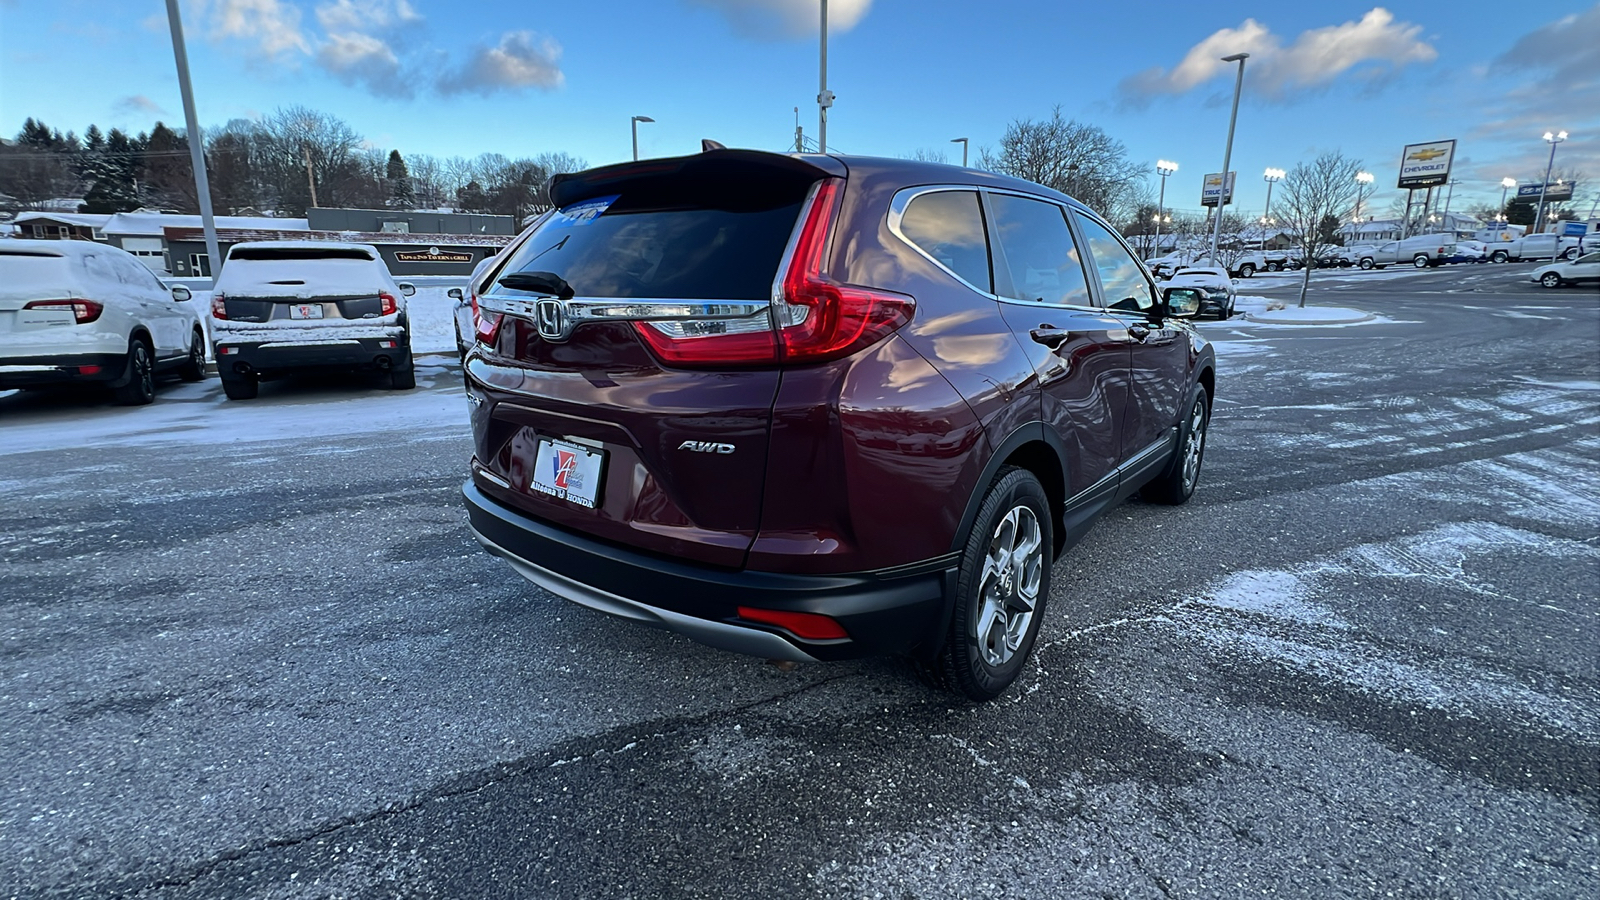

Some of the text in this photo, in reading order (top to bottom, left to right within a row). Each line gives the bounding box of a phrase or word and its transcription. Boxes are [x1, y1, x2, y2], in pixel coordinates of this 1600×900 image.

[1404, 163, 1446, 173] CHEVROLET
[1205, 188, 1230, 196] TRUCS
[677, 440, 736, 454] AWD
[530, 481, 595, 508] Altoona HONDA
